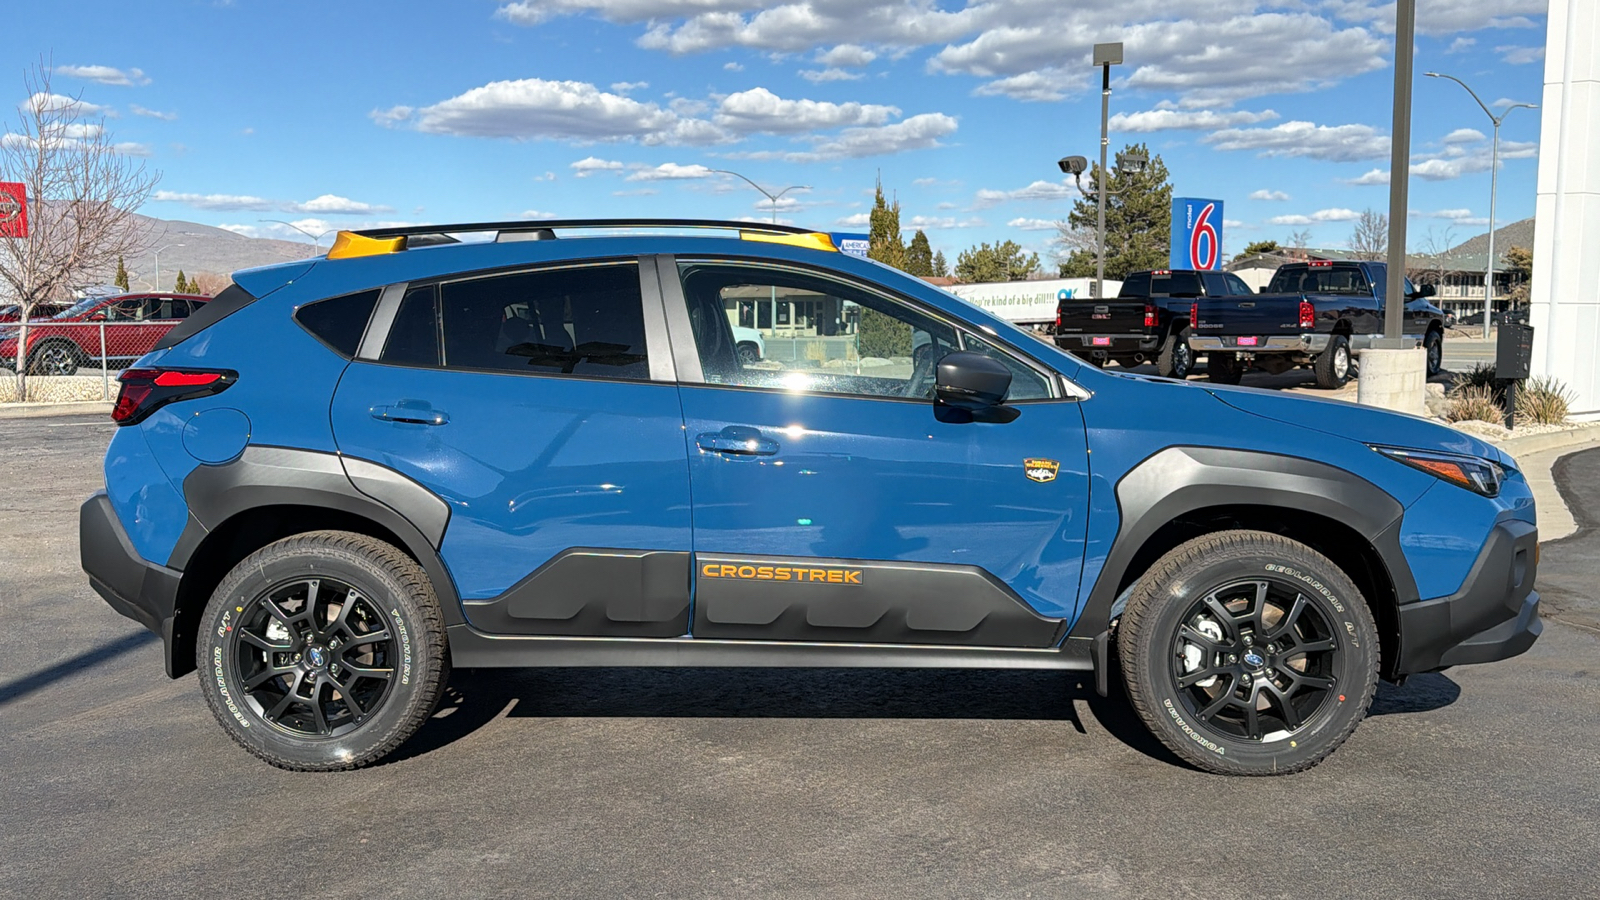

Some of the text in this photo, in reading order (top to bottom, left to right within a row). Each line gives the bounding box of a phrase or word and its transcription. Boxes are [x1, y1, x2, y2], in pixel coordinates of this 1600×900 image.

[1190, 203, 1218, 270] 6
[992, 295, 1007, 306] kind
[1008, 295, 1016, 305] of
[1022, 294, 1033, 307] big
[702, 564, 861, 584] CROSSTREK
[1265, 563, 1359, 648] GEOLANDAR A/T
[214, 610, 250, 728] GEOLANDAR A/T
[391, 608, 411, 685] YOKOHAMA
[1164, 698, 1225, 755] YOKOHAMA
